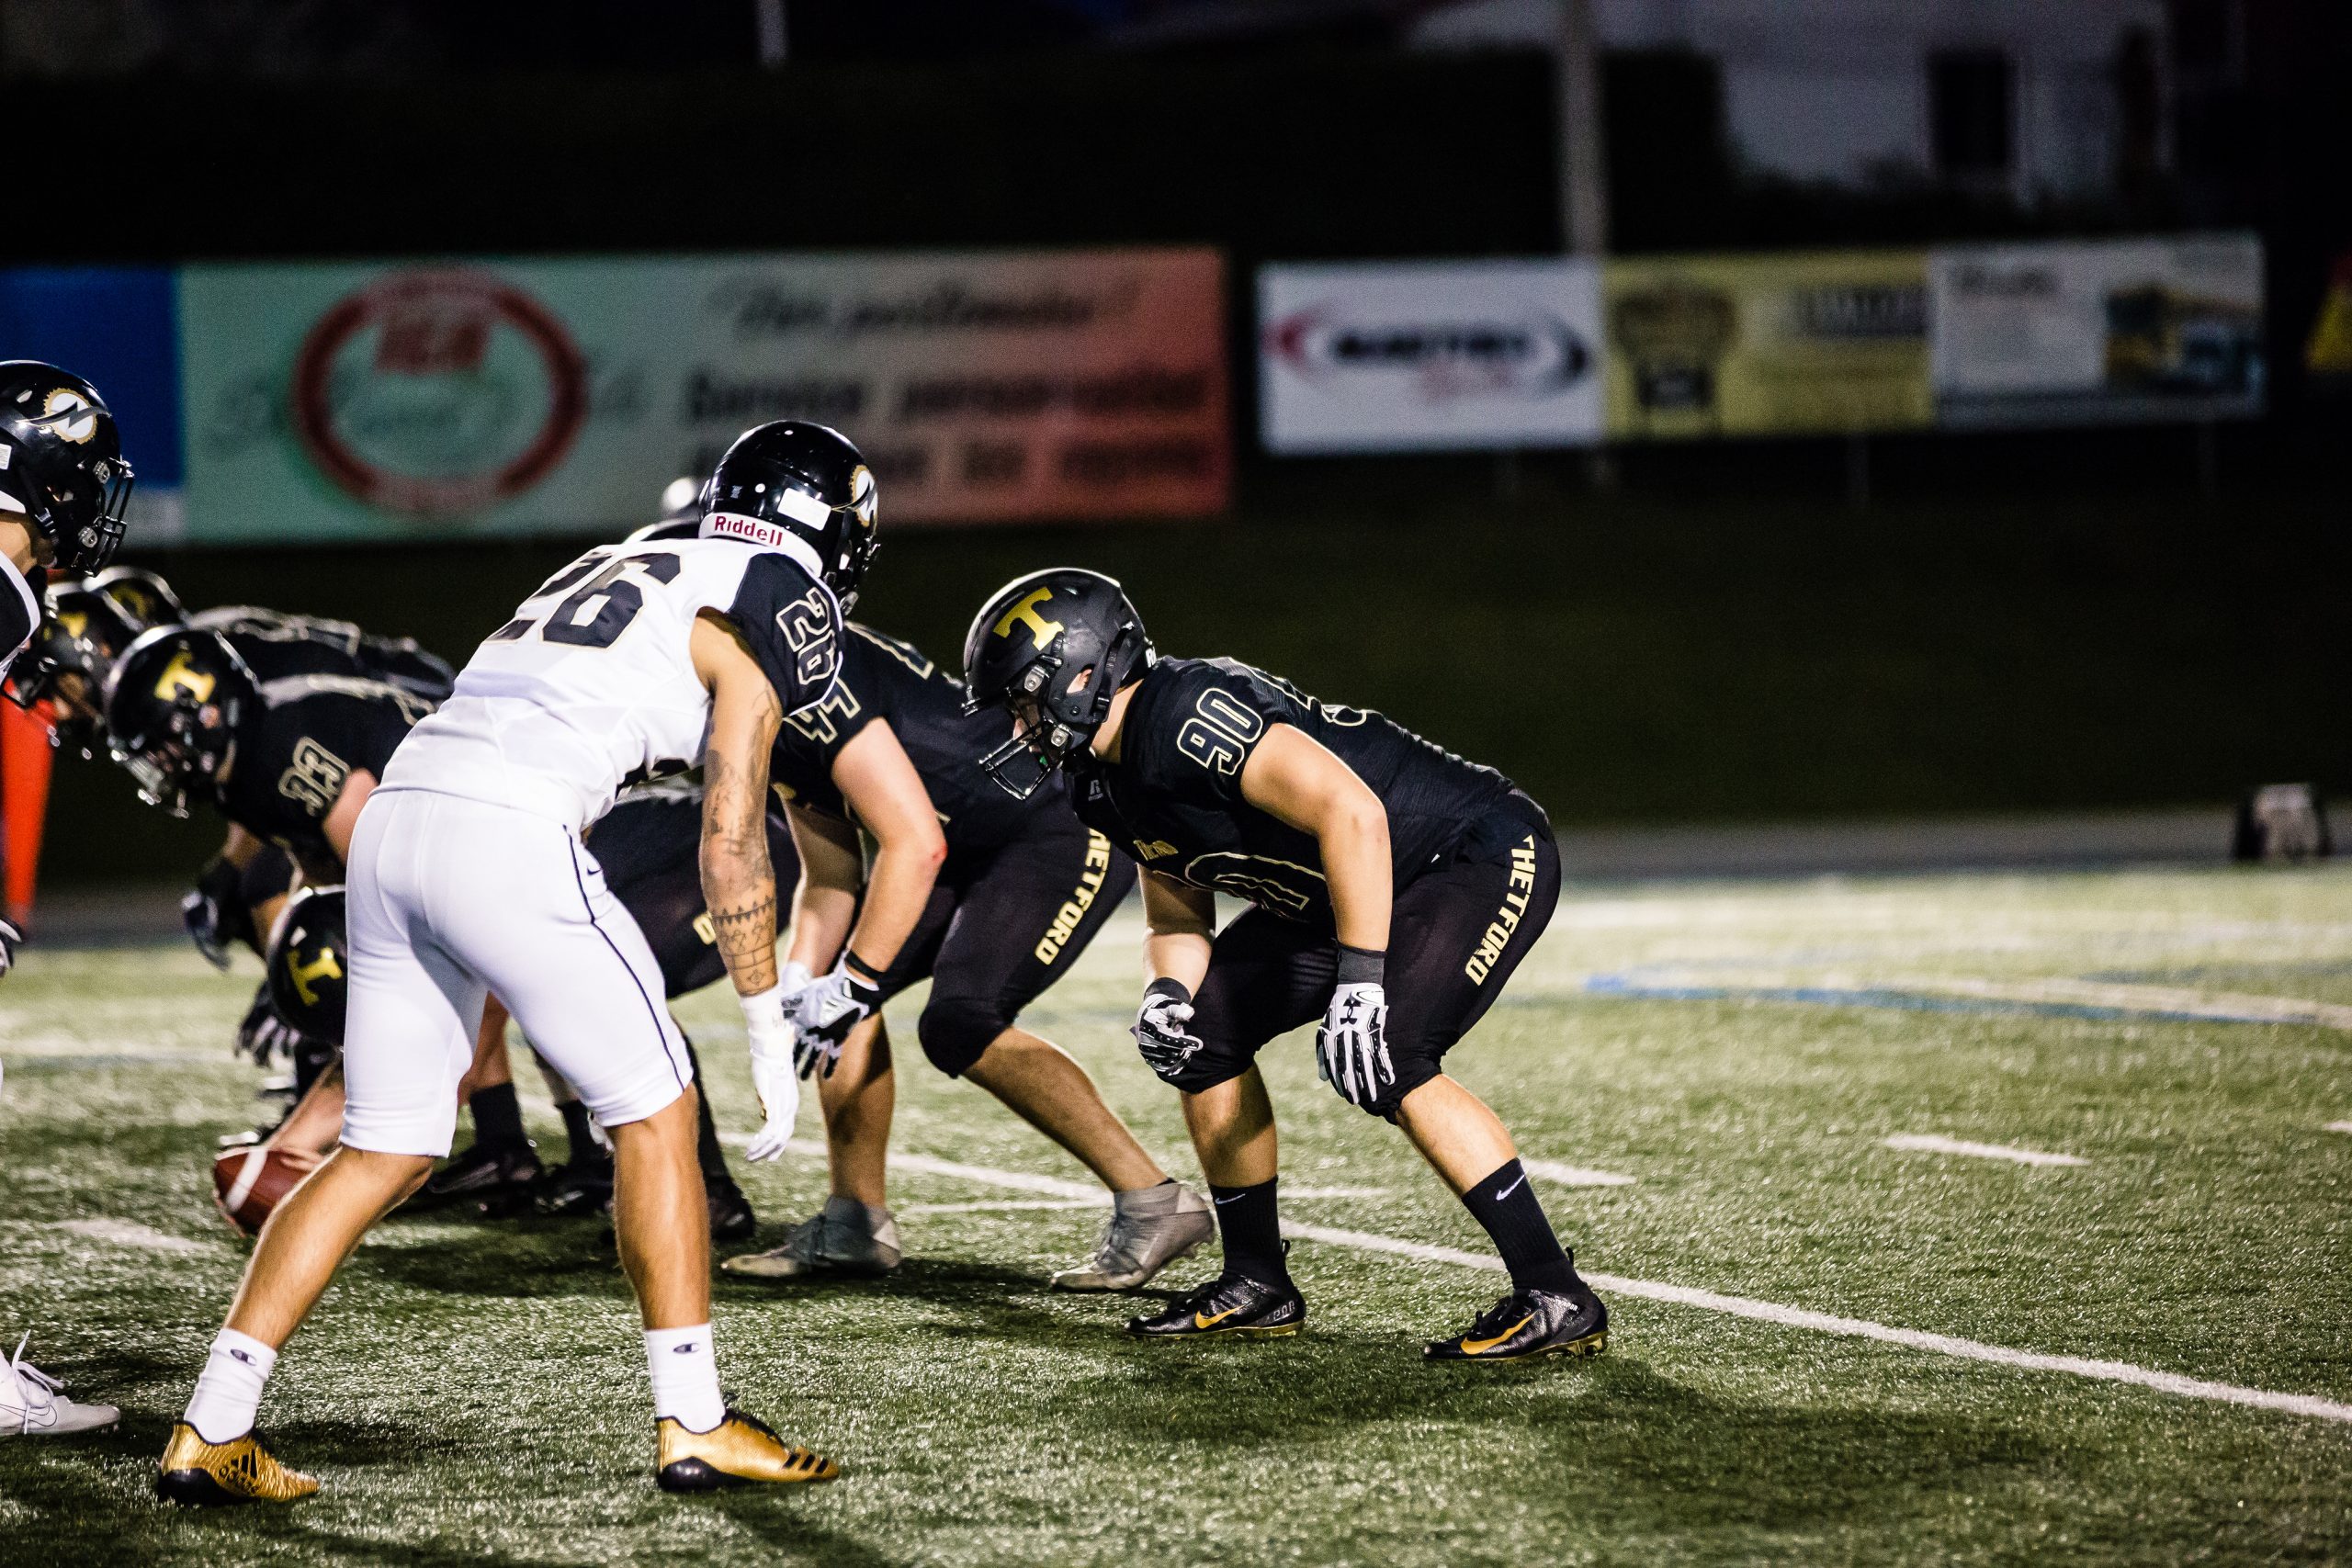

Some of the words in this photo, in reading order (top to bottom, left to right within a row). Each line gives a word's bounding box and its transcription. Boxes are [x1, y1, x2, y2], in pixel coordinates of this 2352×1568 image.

[714, 515, 784, 547] Riddell
[483, 551, 683, 649] 26
[775, 586, 838, 686] 26
[993, 586, 1064, 651] T
[153, 647, 217, 705] T
[1177, 687, 1264, 776] 90
[277, 736, 351, 817] 33
[1035, 828, 1111, 965] HETFORD
[287, 946, 343, 1007] T
